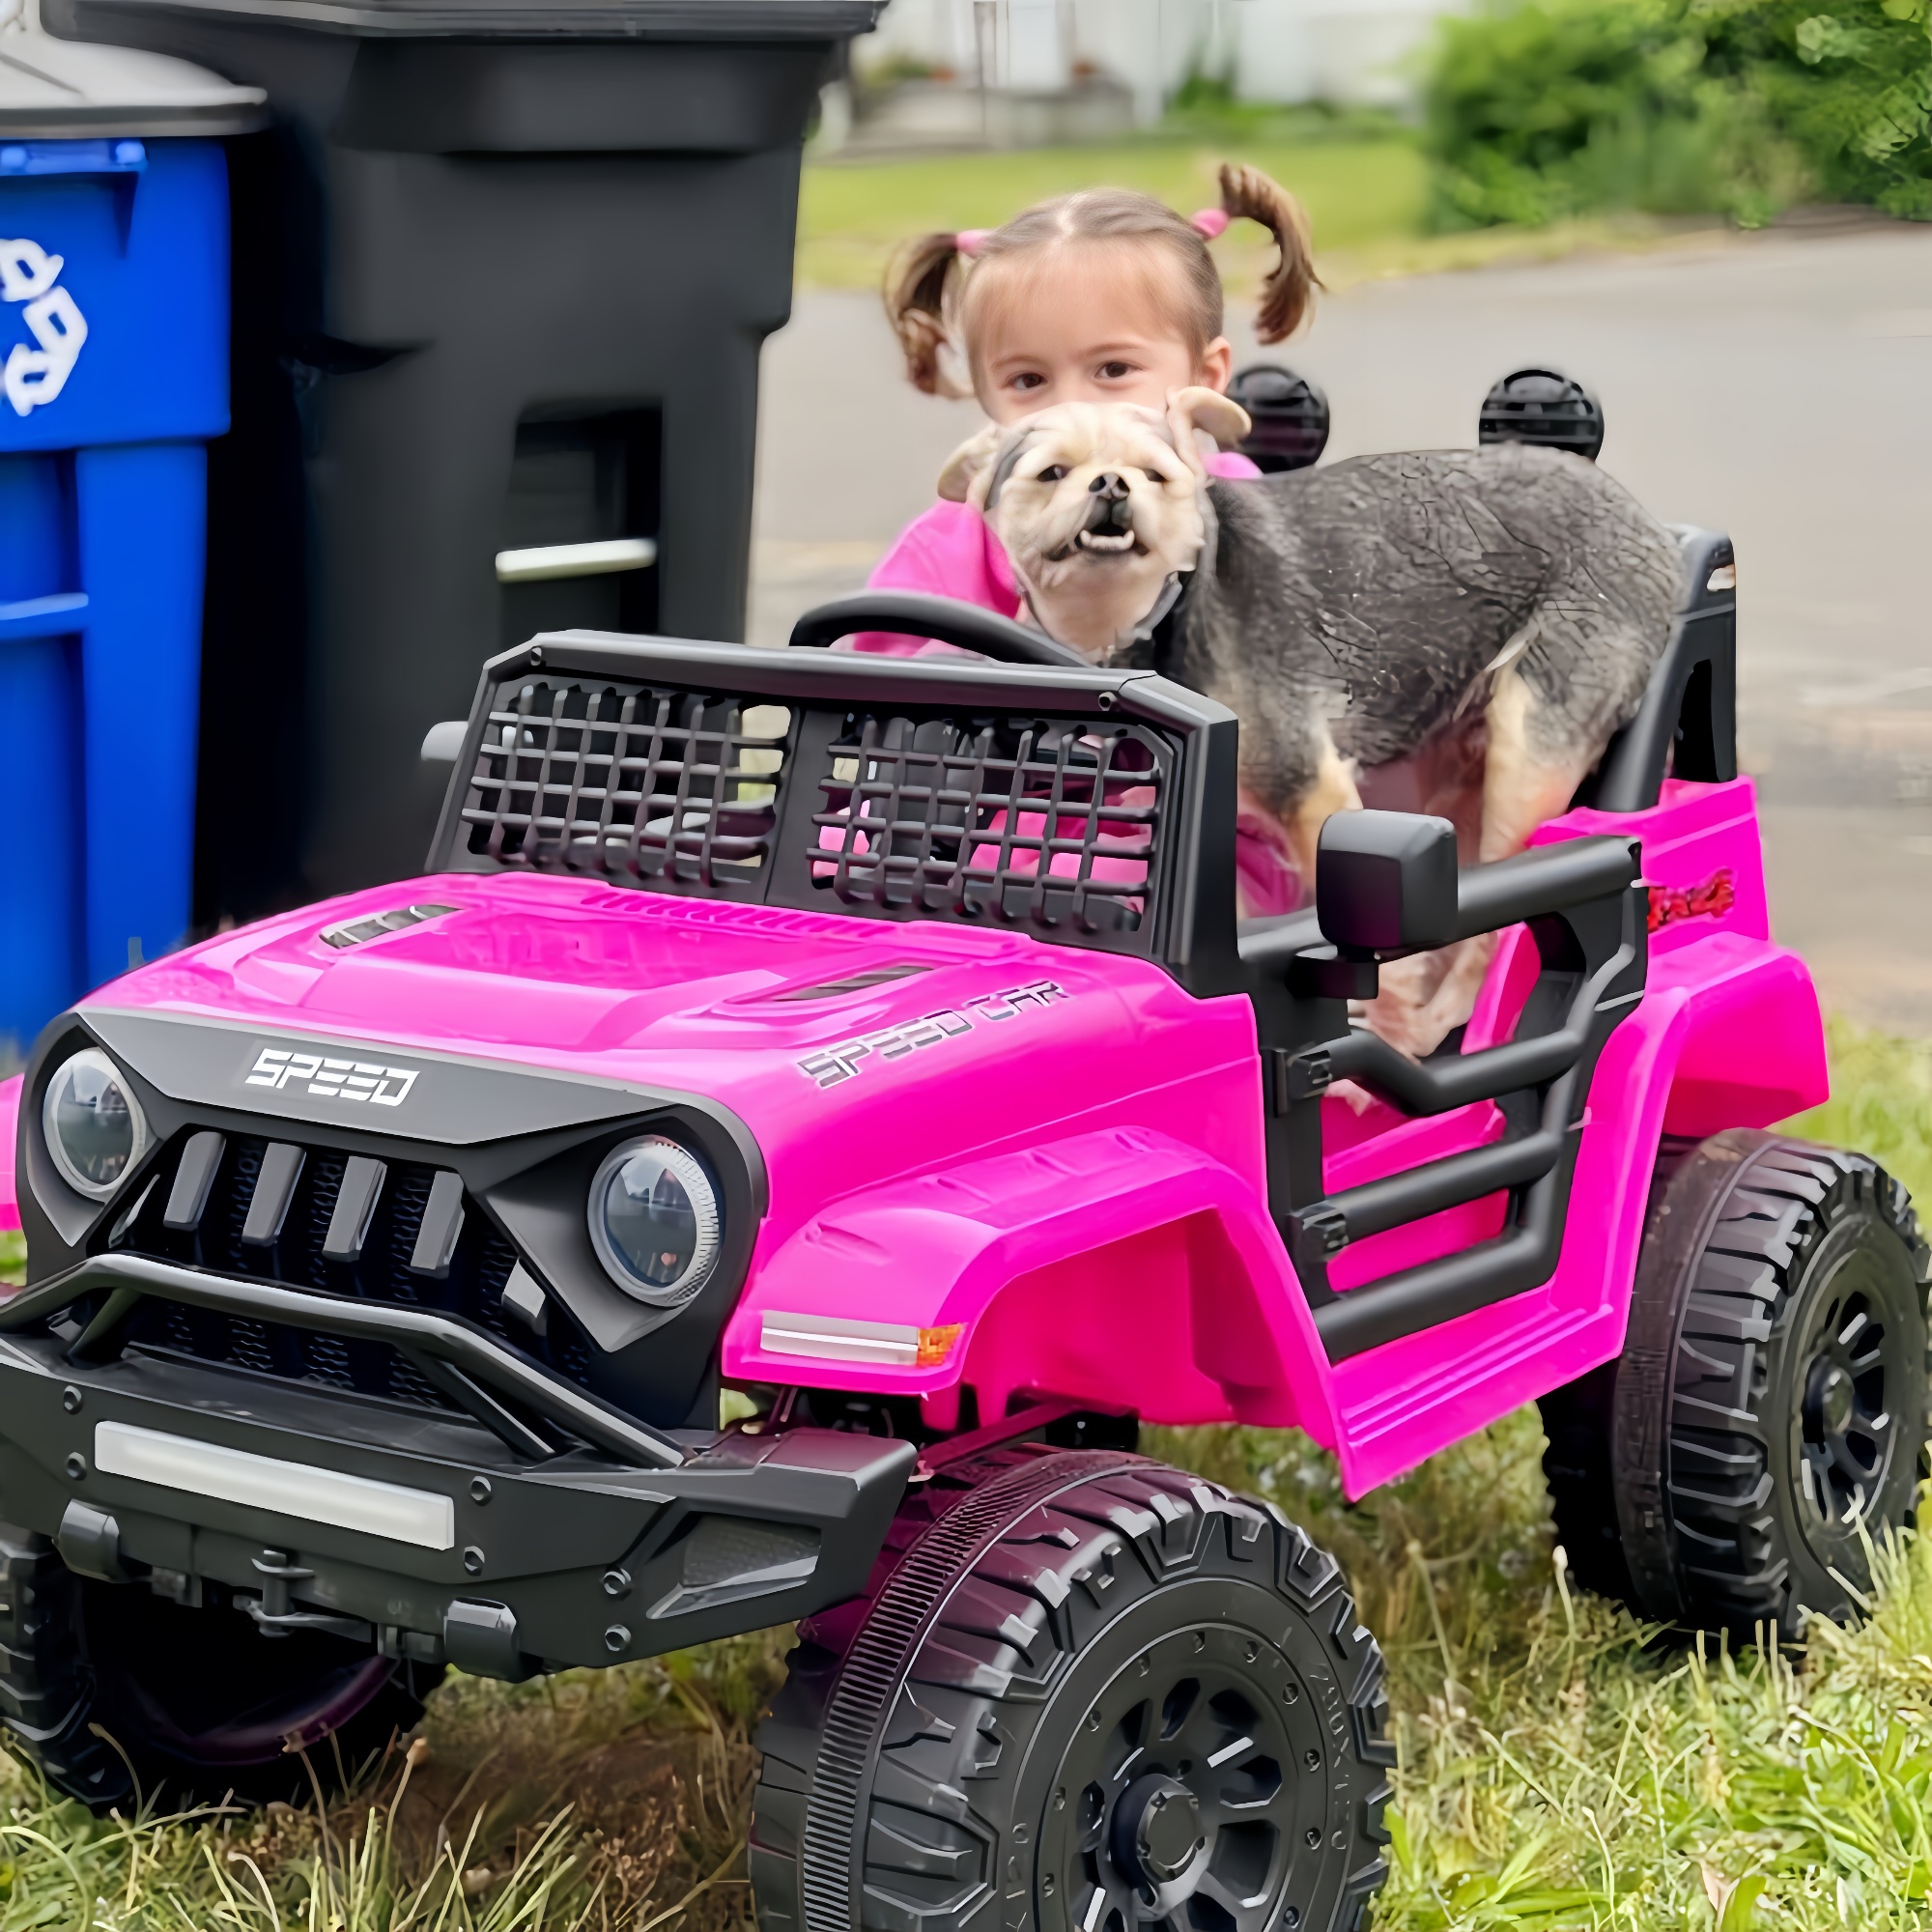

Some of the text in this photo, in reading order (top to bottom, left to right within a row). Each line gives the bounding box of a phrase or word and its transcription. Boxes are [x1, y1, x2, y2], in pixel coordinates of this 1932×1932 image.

[796, 980, 1068, 1088] SPEED CAR
[245, 1048, 420, 1106] SPEED
